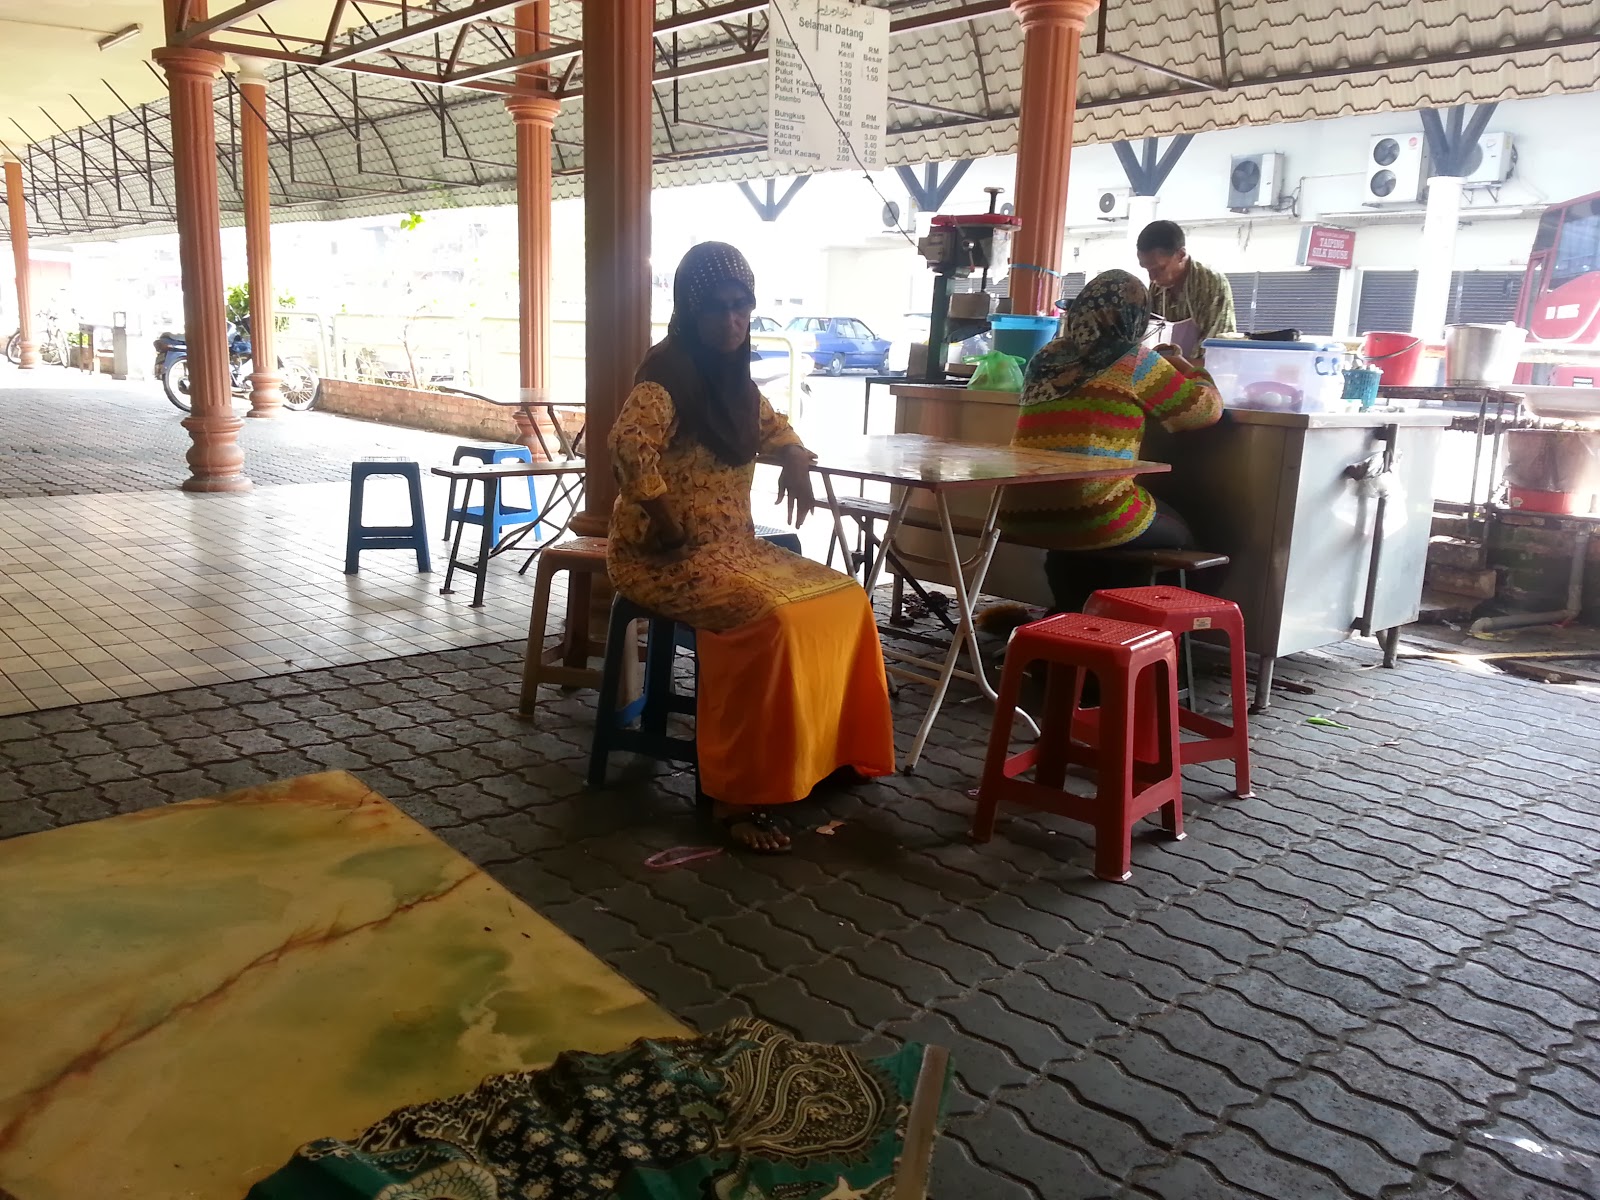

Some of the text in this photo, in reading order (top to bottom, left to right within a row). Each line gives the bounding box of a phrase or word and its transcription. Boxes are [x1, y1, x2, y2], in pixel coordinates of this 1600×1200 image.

[799, 17, 864, 41] Selamat Datang
[776, 50, 796, 59] Biasa
[838, 50, 854, 58] Kecil
[863, 54, 882, 63] Besar
[775, 58, 802, 70] Kacang
[775, 66, 793, 76] Pulut
[775, 75, 822, 90] Pulut Kacang
[775, 84, 793, 93] Pulut
[802, 88, 825, 99] Keping
[775, 110, 805, 120] Bungkus
[775, 122, 794, 131] Biasa
[836, 118, 852, 126] Kecil
[774, 130, 800, 141] Kacang
[774, 139, 792, 147] Pulut
[774, 147, 820, 160] Pulut Kacang
[1320, 238, 1344, 249] TAIPING
[1312, 247, 1348, 259] SILK HOUSE
